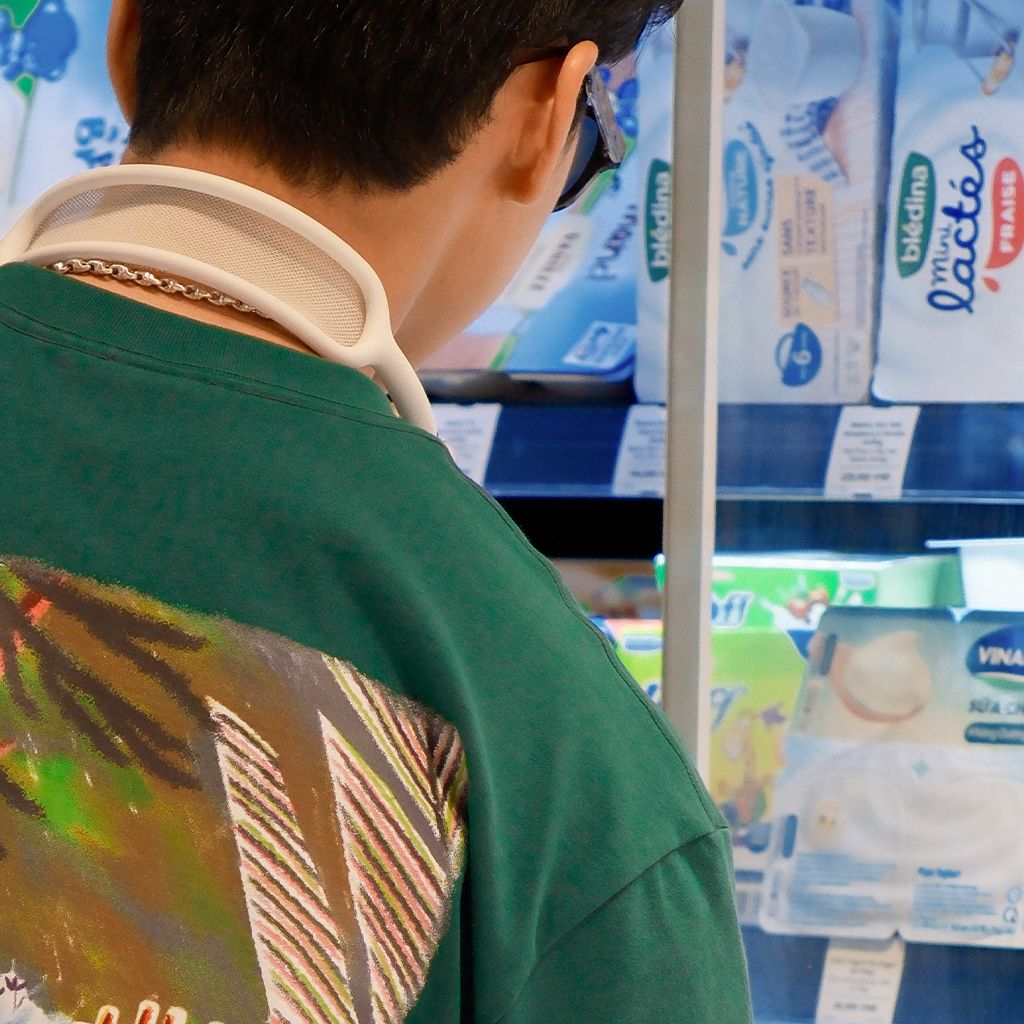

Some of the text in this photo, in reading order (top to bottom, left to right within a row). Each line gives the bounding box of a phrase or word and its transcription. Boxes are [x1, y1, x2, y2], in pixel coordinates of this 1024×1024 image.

[899, 164, 930, 262] blédina
[927, 126, 988, 315] lactés
[994, 169, 1017, 253] FRAISE
